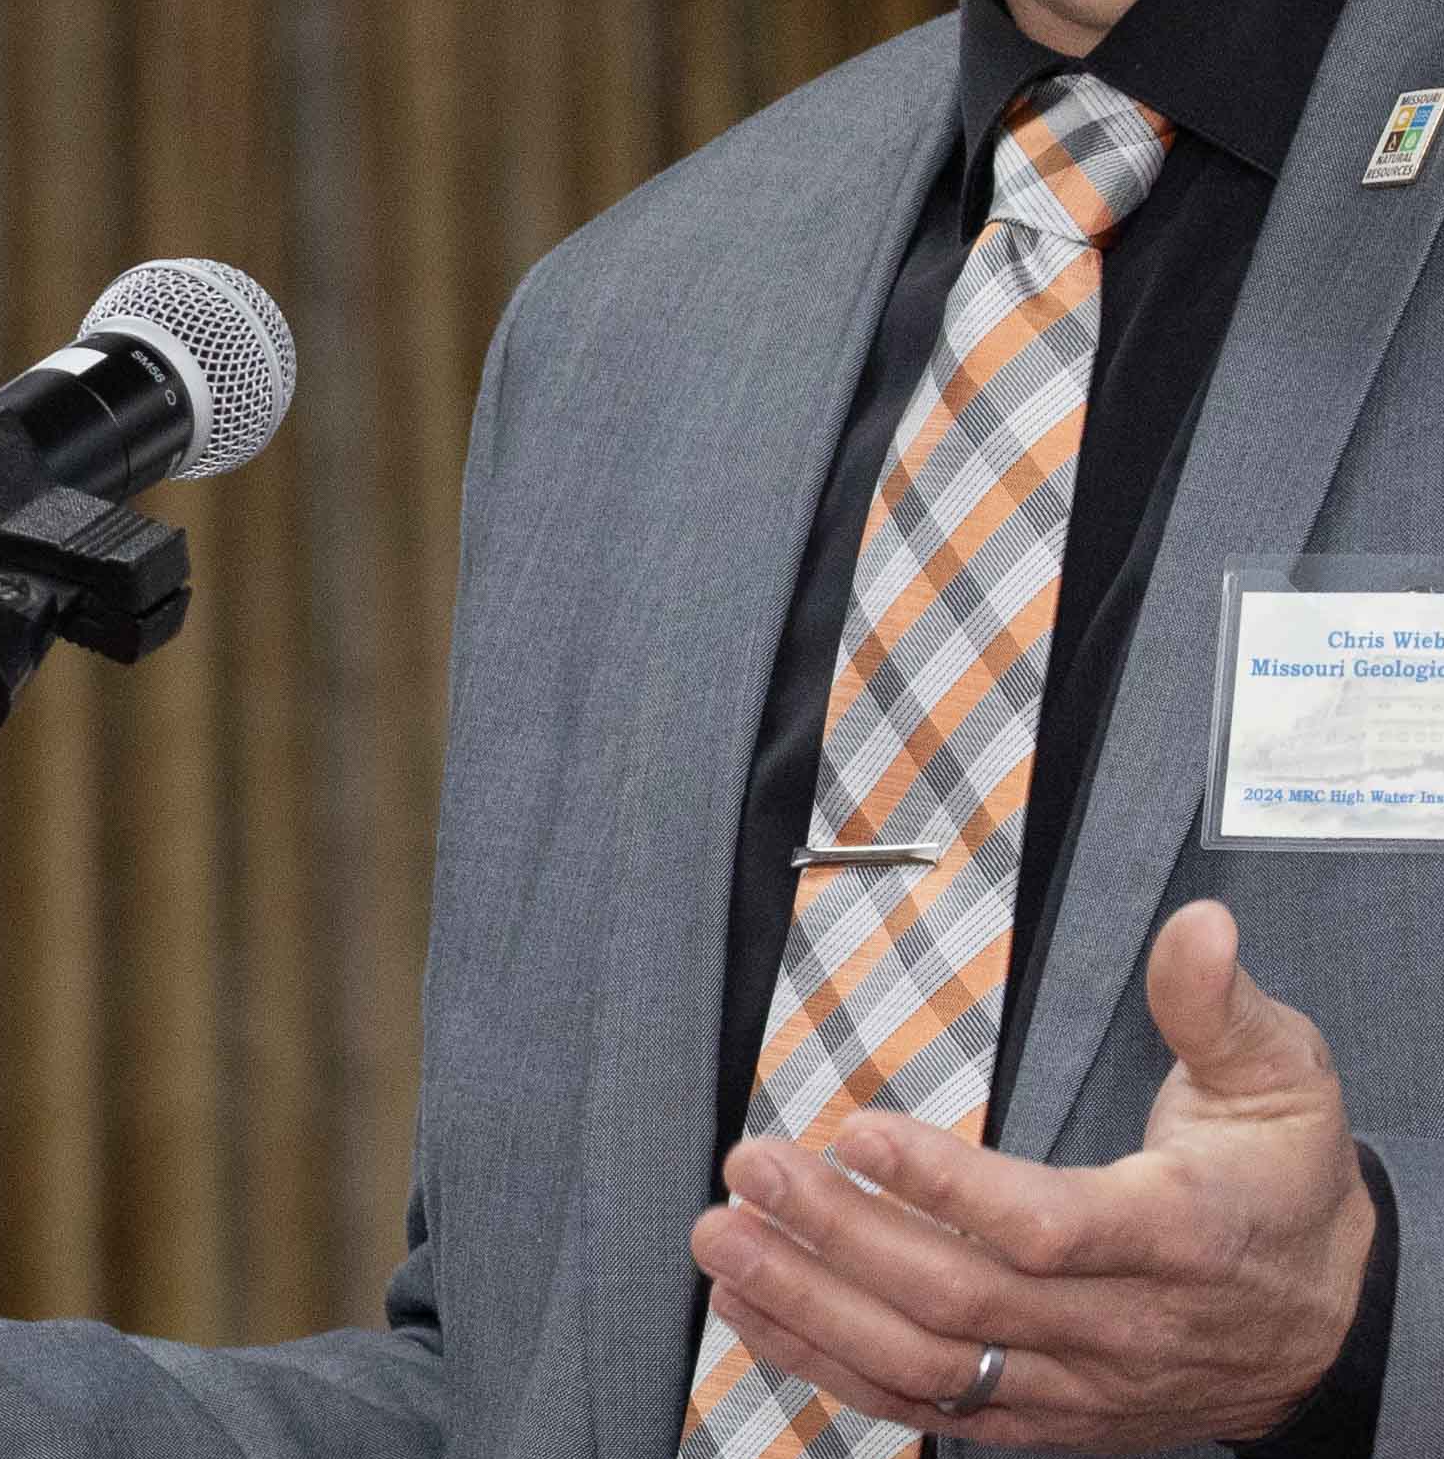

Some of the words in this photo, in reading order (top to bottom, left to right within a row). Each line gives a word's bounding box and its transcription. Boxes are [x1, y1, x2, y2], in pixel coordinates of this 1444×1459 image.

[1377, 153, 1413, 164] NATURAL
[1367, 164, 1414, 179] RESOURCES
[131, 350, 166, 383] SM58
[1327, 630, 1385, 649] Chris
[1250, 658, 1345, 678] Missouri
[1243, 788, 1284, 802] 2024
[1288, 789, 1326, 802] MRC
[1330, 789, 1365, 805] High
[1370, 789, 1417, 805] Water
